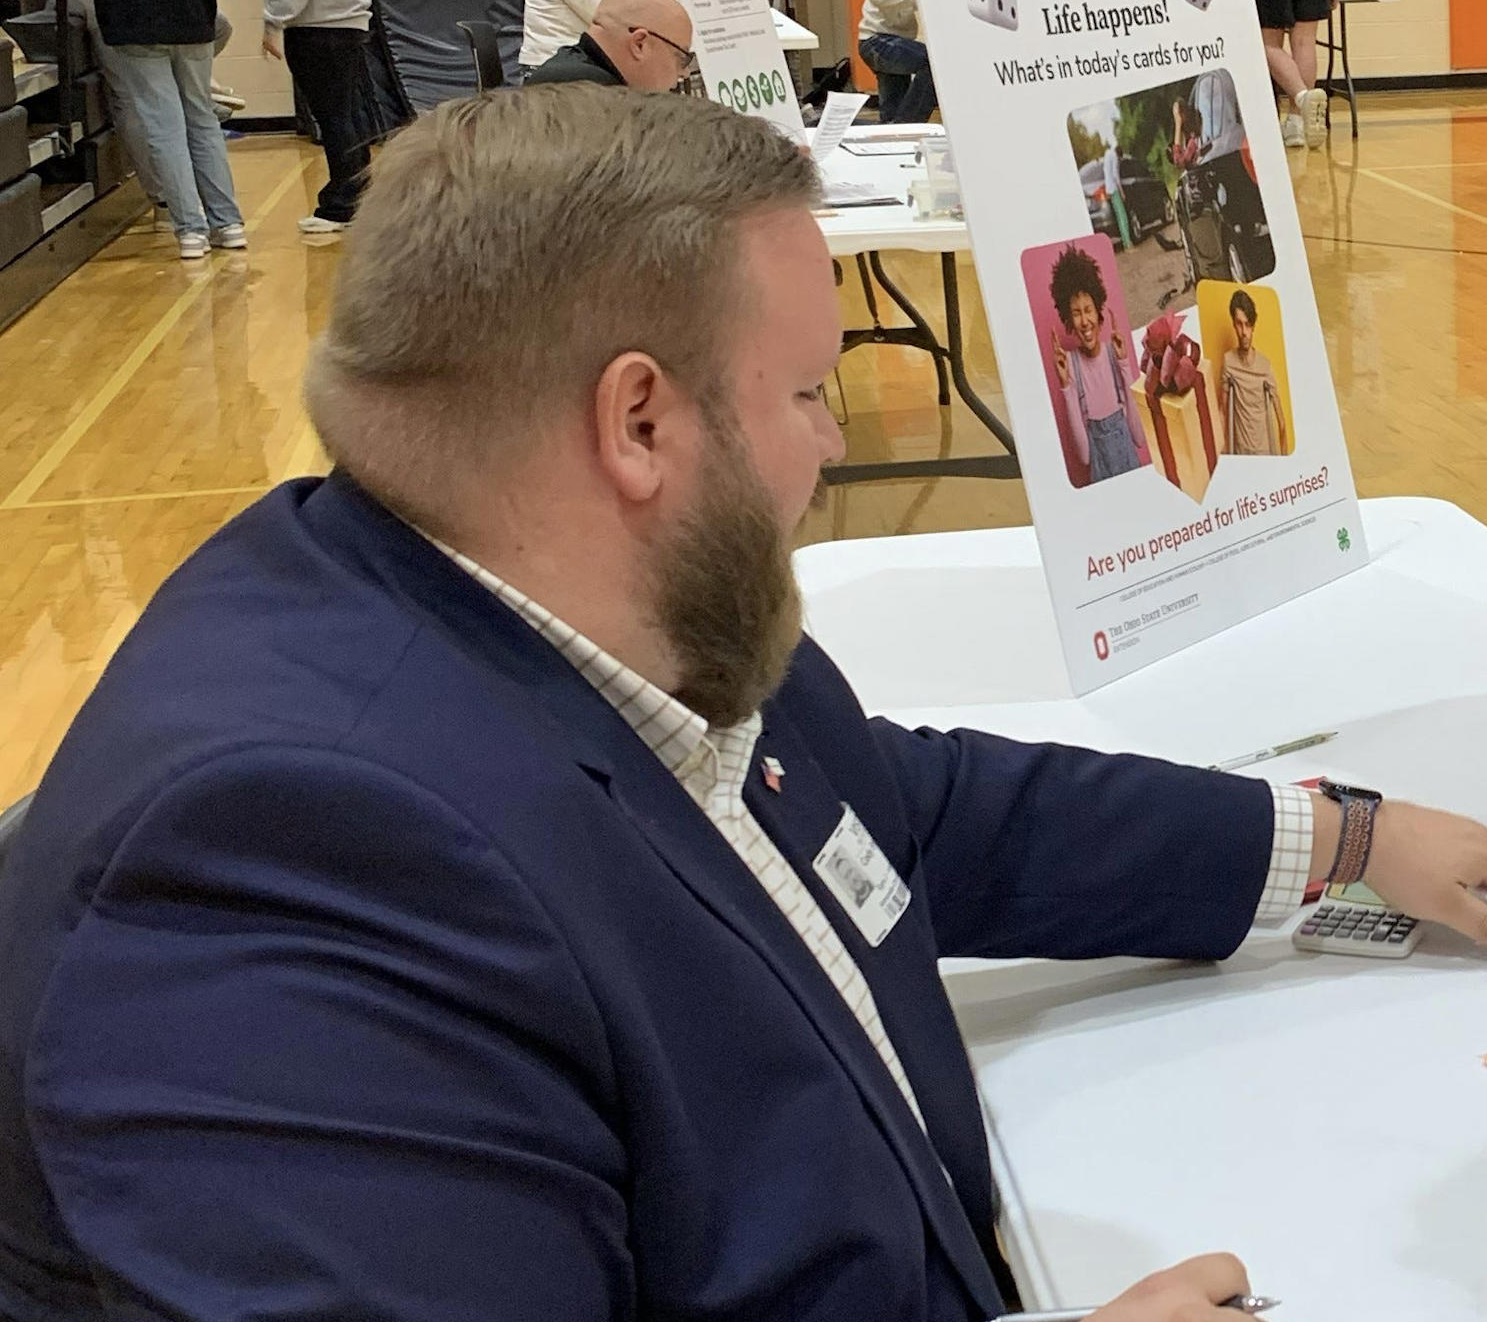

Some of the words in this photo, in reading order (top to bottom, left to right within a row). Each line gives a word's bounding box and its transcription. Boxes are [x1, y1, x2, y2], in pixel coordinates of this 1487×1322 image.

[1041, 3, 1082, 36] Life
[993, 57, 1054, 86] What's
[1055, 55, 1074, 79] in
[1074, 48, 1131, 78] today's
[1133, 43, 1172, 70] cards
[1172, 41, 1193, 65] for
[1195, 36, 1225, 67] you?
[1086, 555, 1114, 582] Are
[1116, 542, 1146, 573] you
[1148, 511, 1213, 561] prepared
[1214, 507, 1235, 531] for
[1235, 492, 1267, 523] life's
[1268, 465, 1330, 509] surprises?
